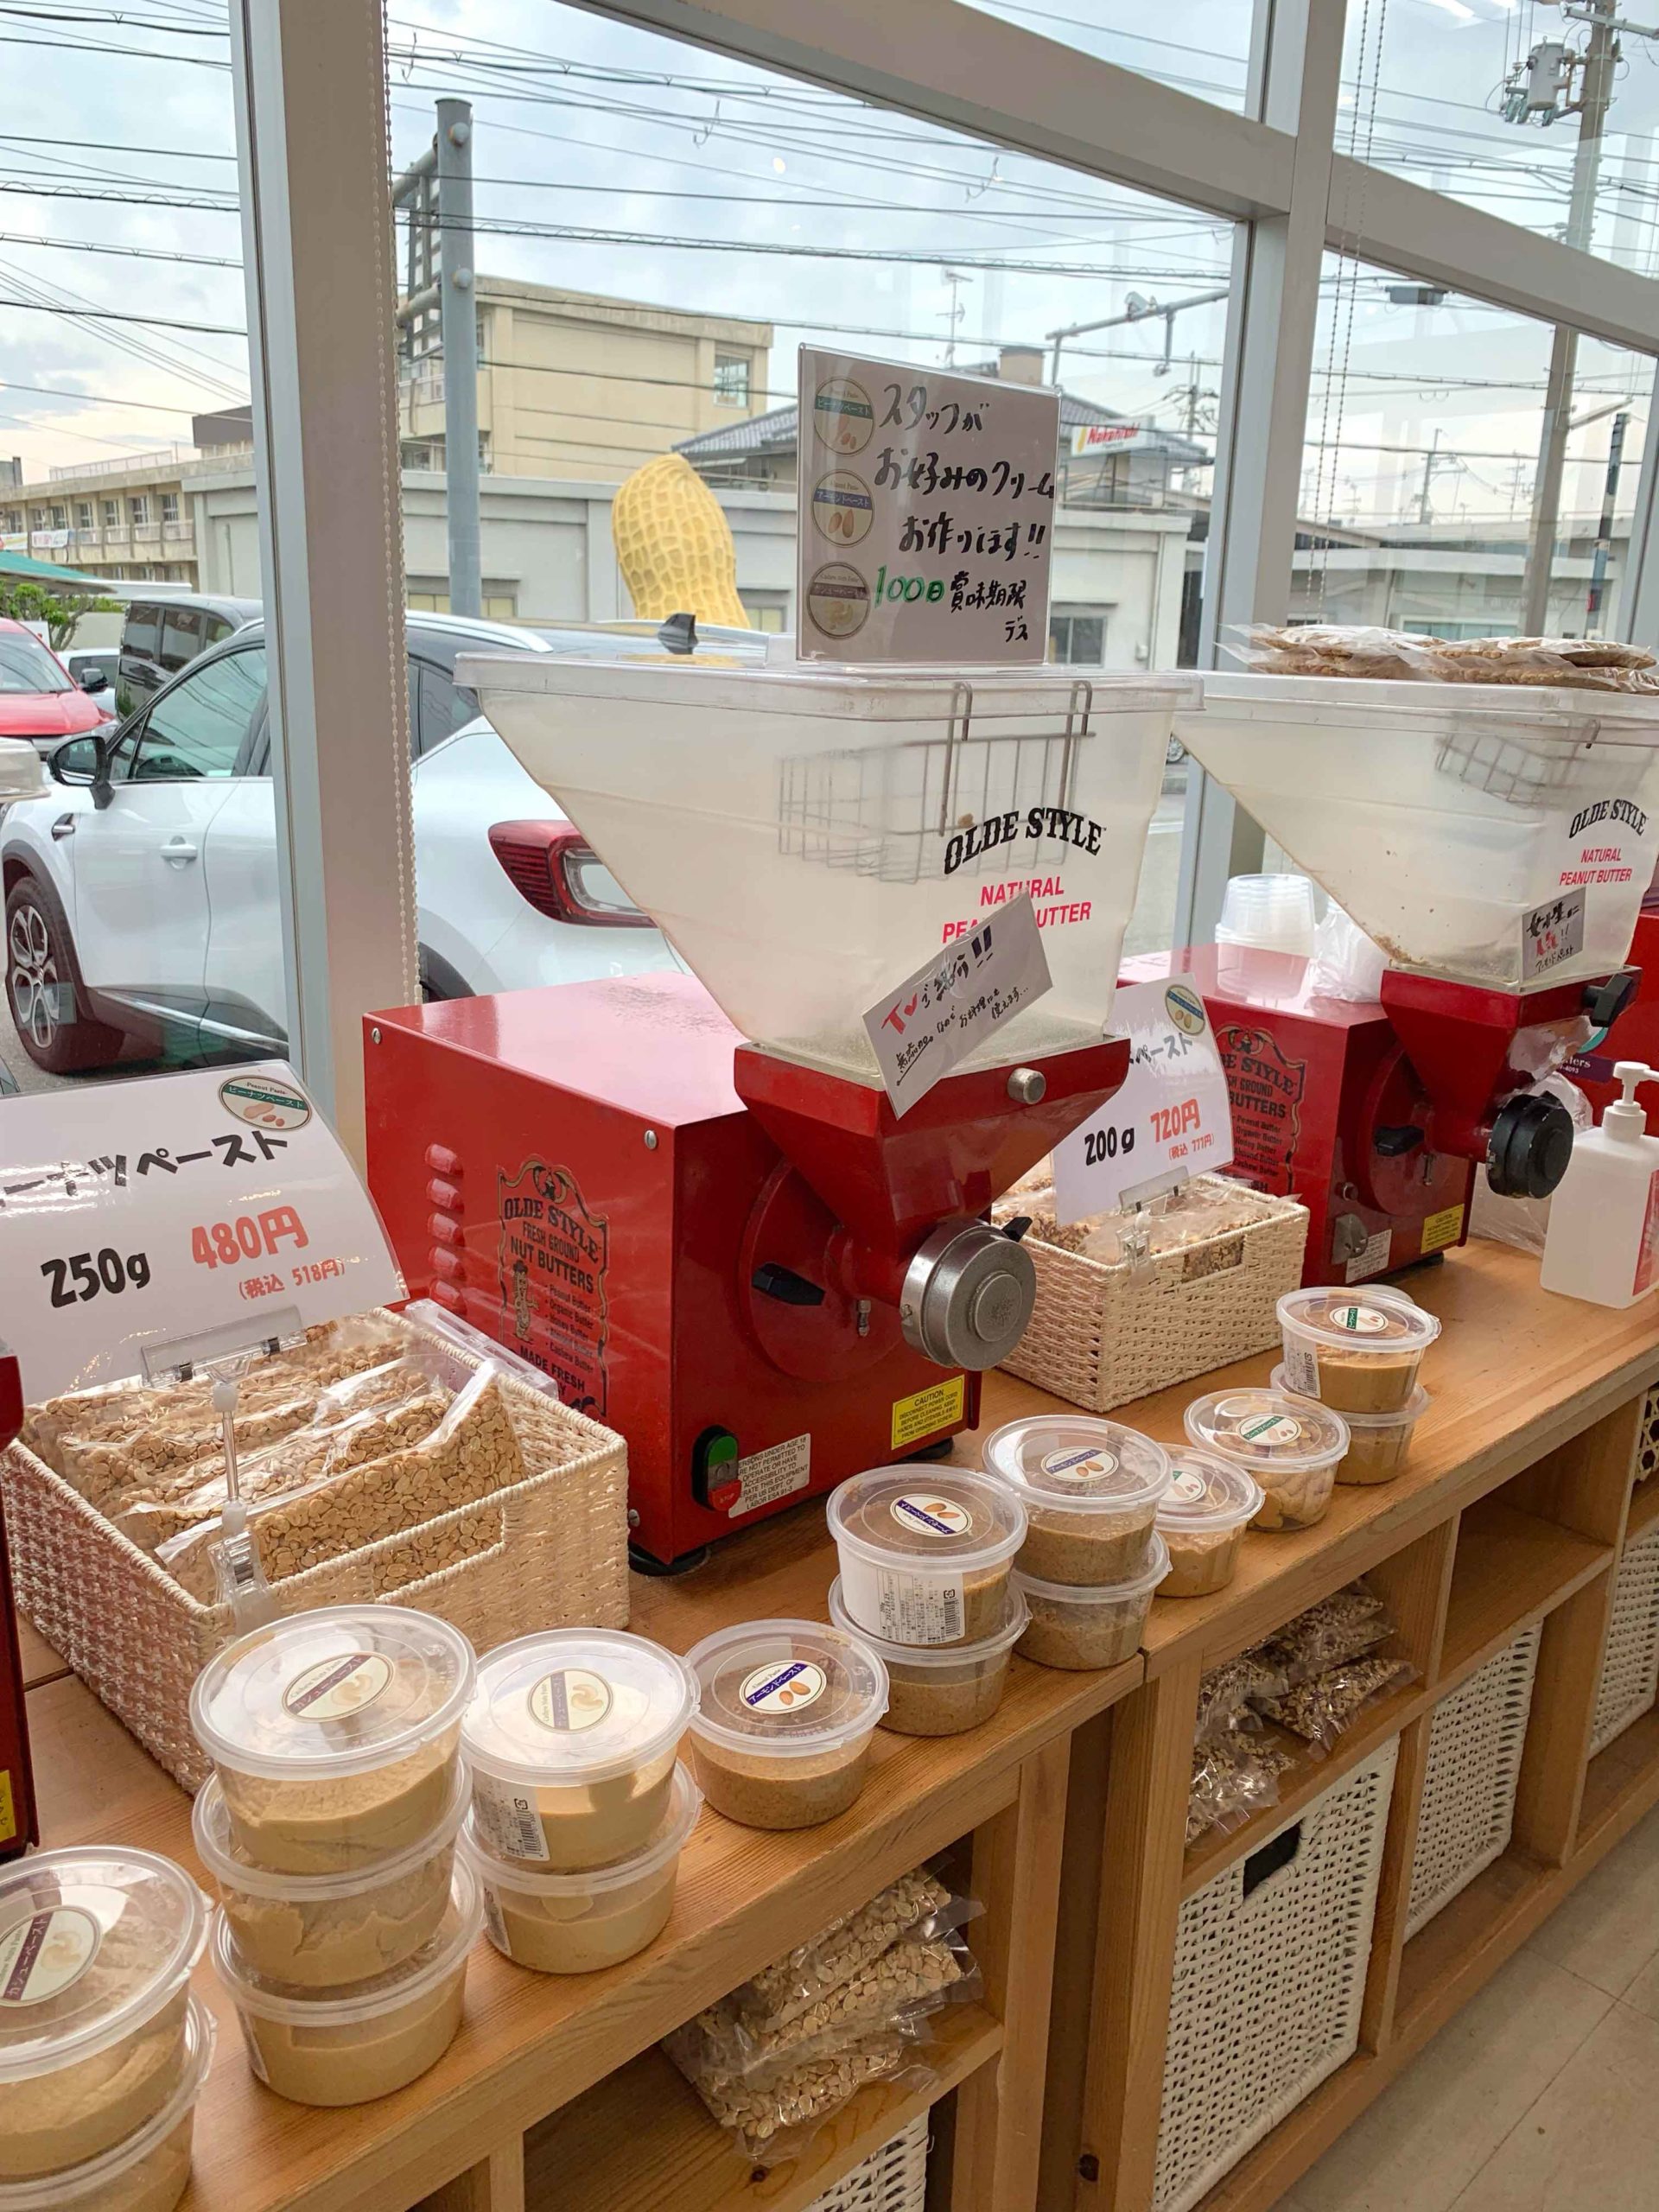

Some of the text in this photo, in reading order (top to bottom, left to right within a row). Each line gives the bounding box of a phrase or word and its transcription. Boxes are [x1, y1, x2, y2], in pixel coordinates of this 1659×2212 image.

[879, 383, 990, 434] スタッフが
[874, 447, 1054, 499] お好みのクリーム
[1568, 798, 1646, 839] OLDE STYLE
[944, 807, 1102, 875] OLDE STYLE
[1580, 848, 1622, 864] NATURAL
[1559, 868, 1633, 887] PEANUT BUTTER
[1037, 902, 1092, 929] UTTER
[1129, 1032, 1193, 1065] ペースト
[1240, 1077, 1273, 1097] GROUND
[1242, 1057, 1294, 1096] STYLE
[1150, 1098, 1201, 1142] 720円
[0, 1130, 288, 1207] ーナツペースト
[191, 1205, 309, 1269] 480円
[504, 1198, 600, 1265] OLDE STYLE
[523, 1221, 581, 1263] FRESH GROUND
[40, 1248, 151, 1309] 250g
[511, 1236, 594, 1294] NUT BUTTERS
[238, 1274, 286, 1300] (税込
[520, 1344, 549, 1372] MADE
[550, 1363, 586, 1394] FRESH
[914, 1389, 944, 1407] CAUTION
[739, 1455, 764, 1468] ERSONS
[765, 1445, 785, 1458] UNDER
[786, 1439, 798, 1449] AGE
[742, 1453, 798, 1483] OPERATE OR HAVE
[749, 1461, 761, 1471] NOT
[763, 1448, 797, 1466] PERMITTED
[744, 1466, 787, 1489] ACCESSIBILITY
[745, 1493, 758, 1503] PER
[759, 1489, 767, 1497] US
[760, 1480, 774, 1490] THIS
[774, 1464, 808, 1484] EQUIPMENT
[747, 1497, 766, 1510] LABOR
[767, 1491, 779, 1501] ESA
[749, 1664, 802, 1702] アーモンドペースト
[7, 1917, 49, 1996] カシューペースト
